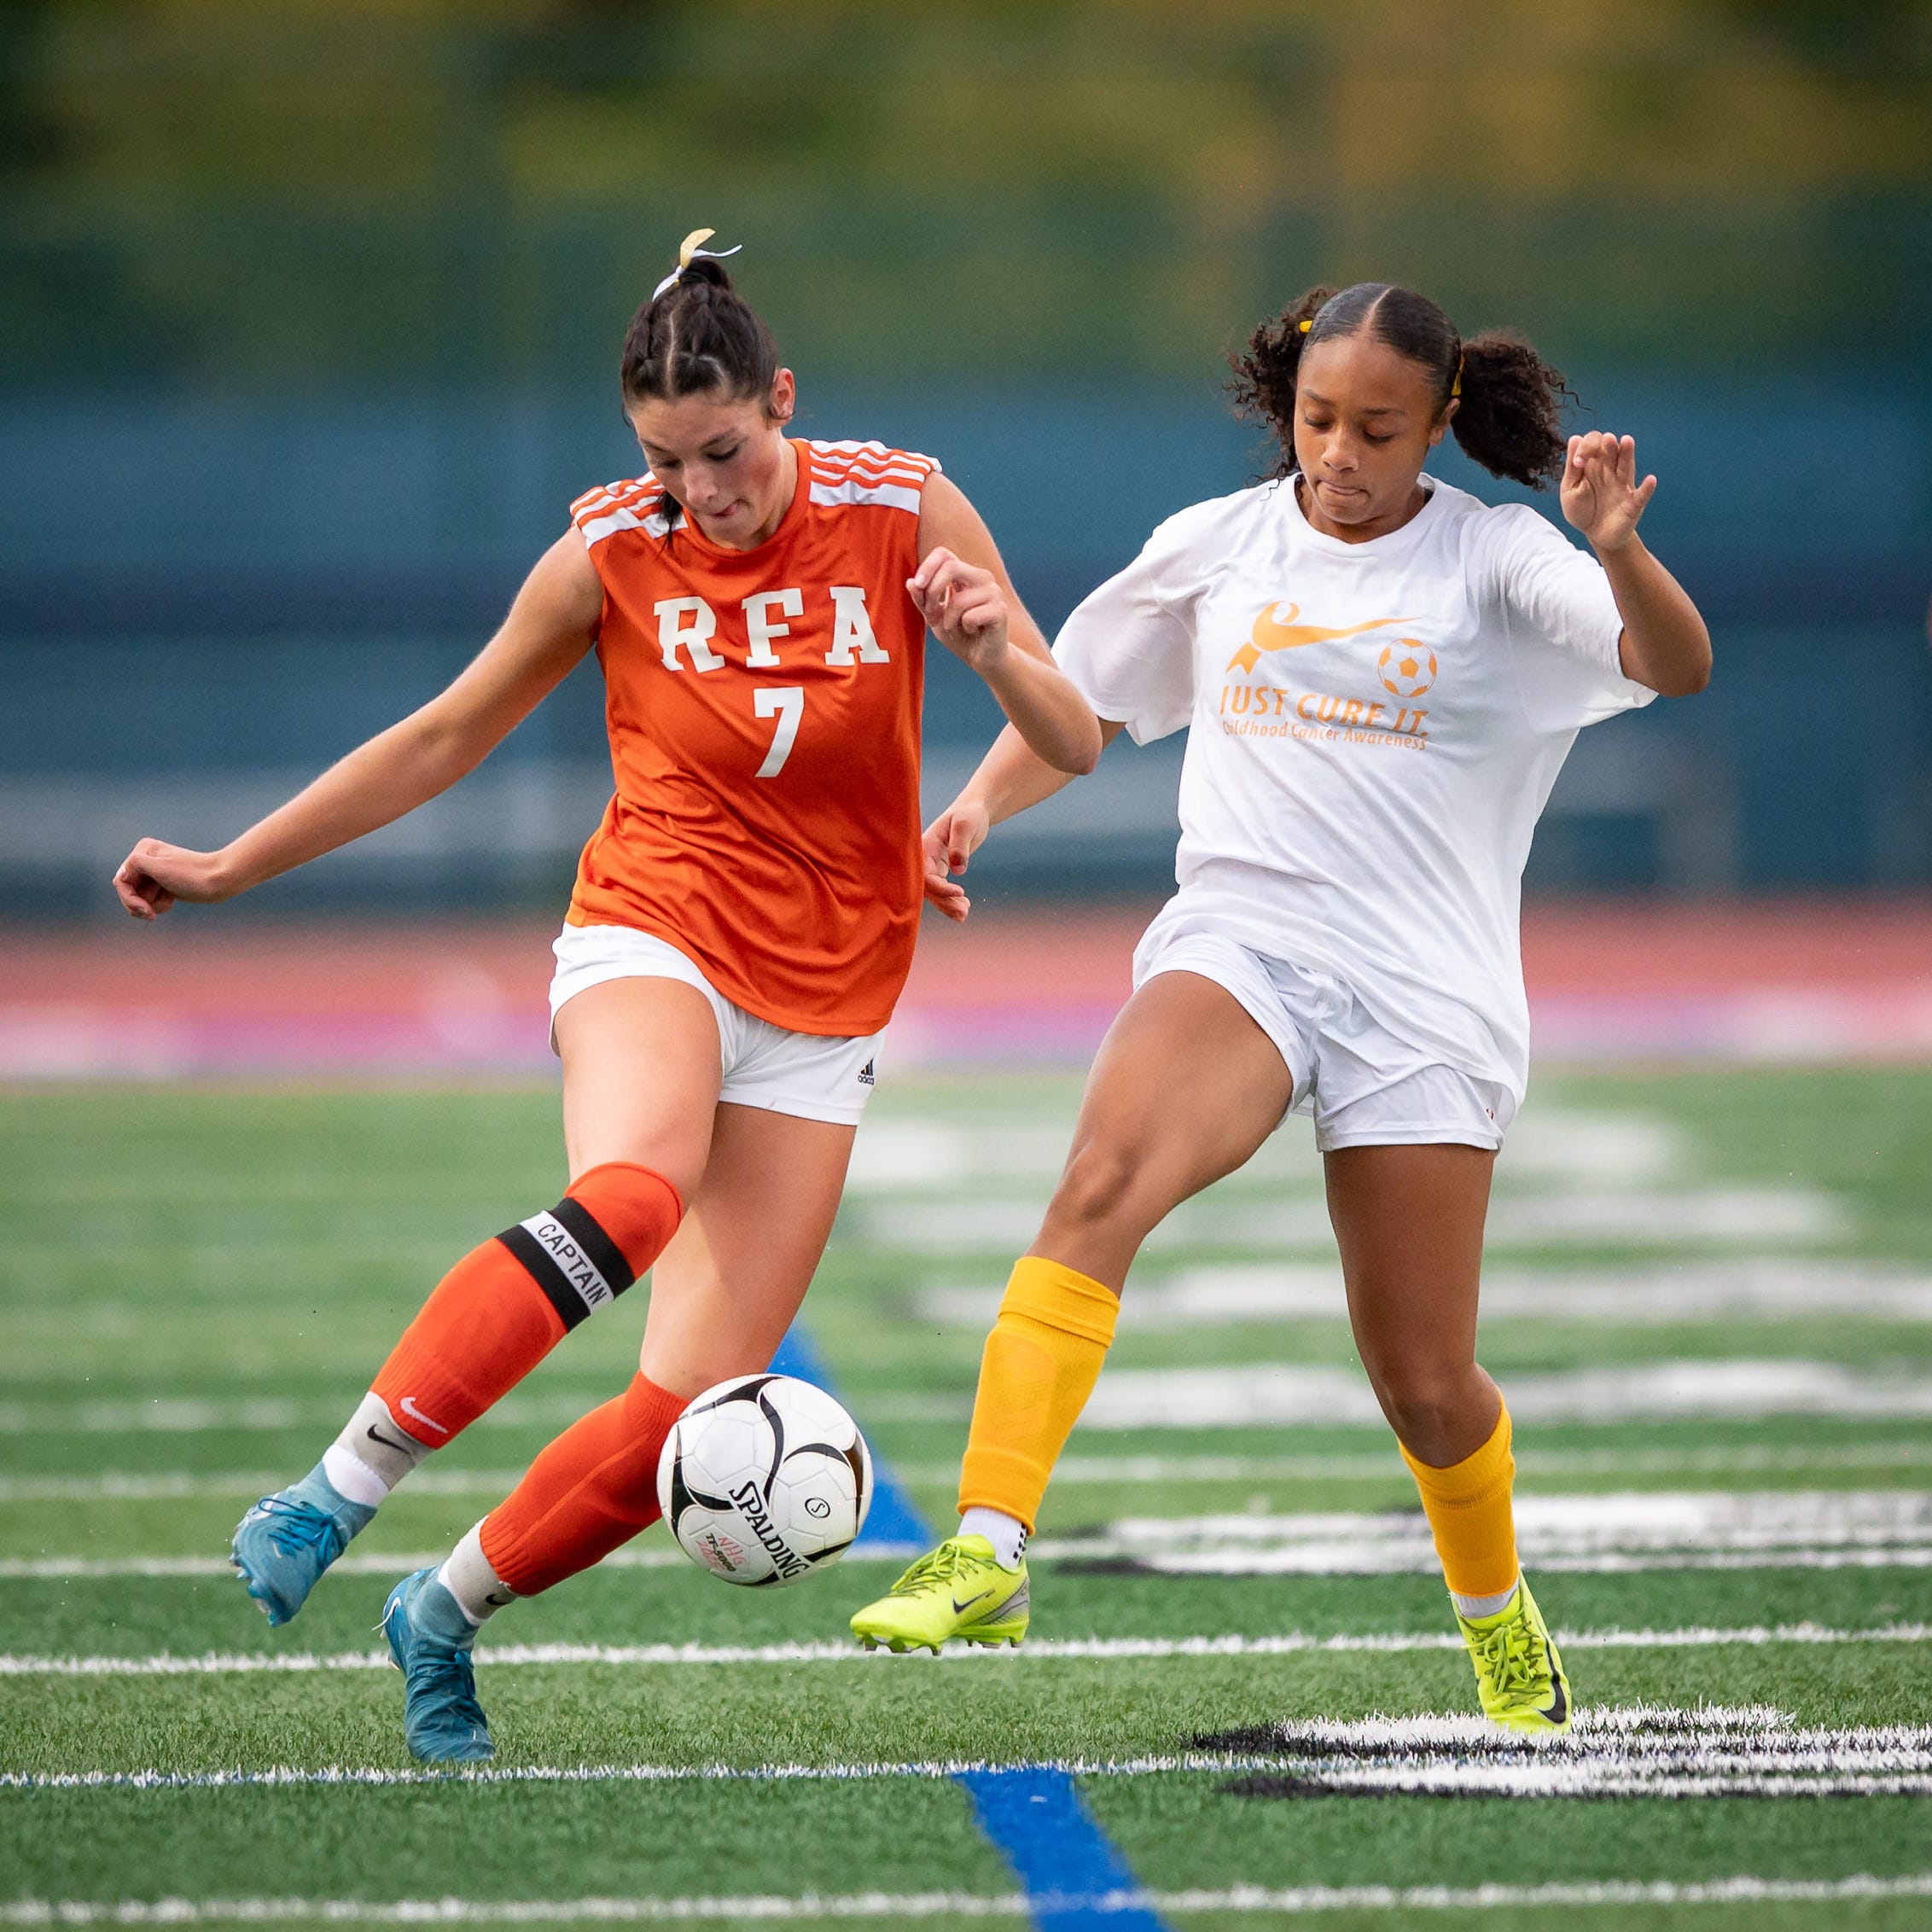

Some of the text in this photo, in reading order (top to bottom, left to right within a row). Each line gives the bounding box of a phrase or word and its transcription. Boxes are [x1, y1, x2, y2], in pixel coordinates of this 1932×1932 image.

[654, 585, 890, 673] RFA
[754, 686, 805, 778] 7
[1219, 684, 1429, 738] JUST CURE IT.
[1291, 723, 1340, 742] Cancer
[1343, 728, 1427, 751] Awareness
[538, 1224, 608, 1305] CAPTAIN
[729, 1481, 810, 1579] SPALDING
